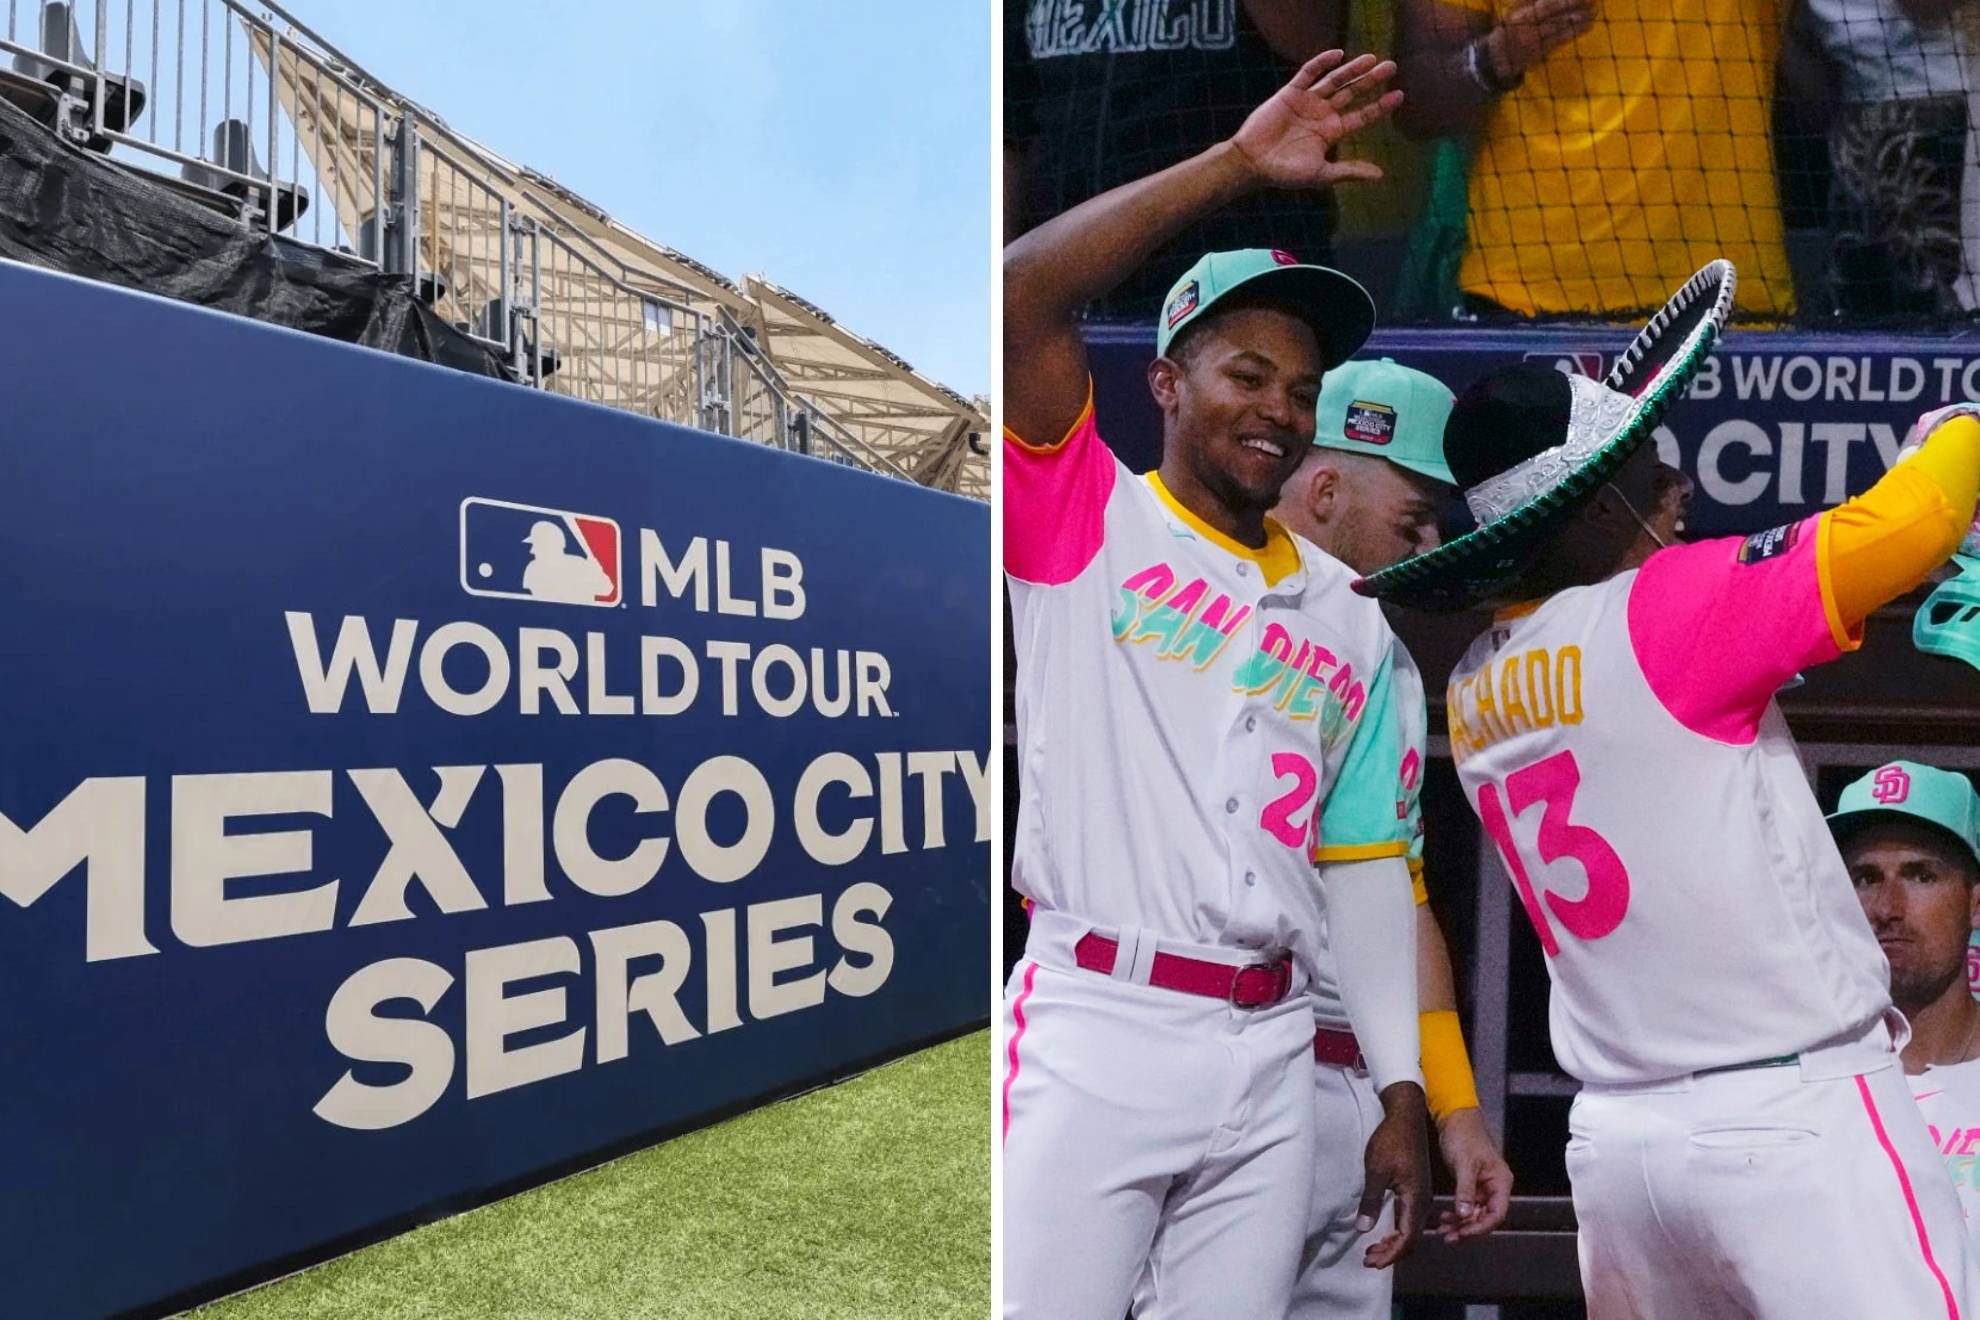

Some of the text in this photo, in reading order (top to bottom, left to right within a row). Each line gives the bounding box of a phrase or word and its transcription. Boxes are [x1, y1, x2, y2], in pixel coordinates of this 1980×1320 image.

[1732, 356, 1925, 402] WORLD
[641, 528, 807, 620] MLB
[1111, 562, 1251, 673] SAN
[285, 610, 894, 718] WORLD TOUR
[1872, 765, 1911, 804] SD
[1477, 749, 1631, 958] 13
[312, 882, 894, 1130] SERIES
